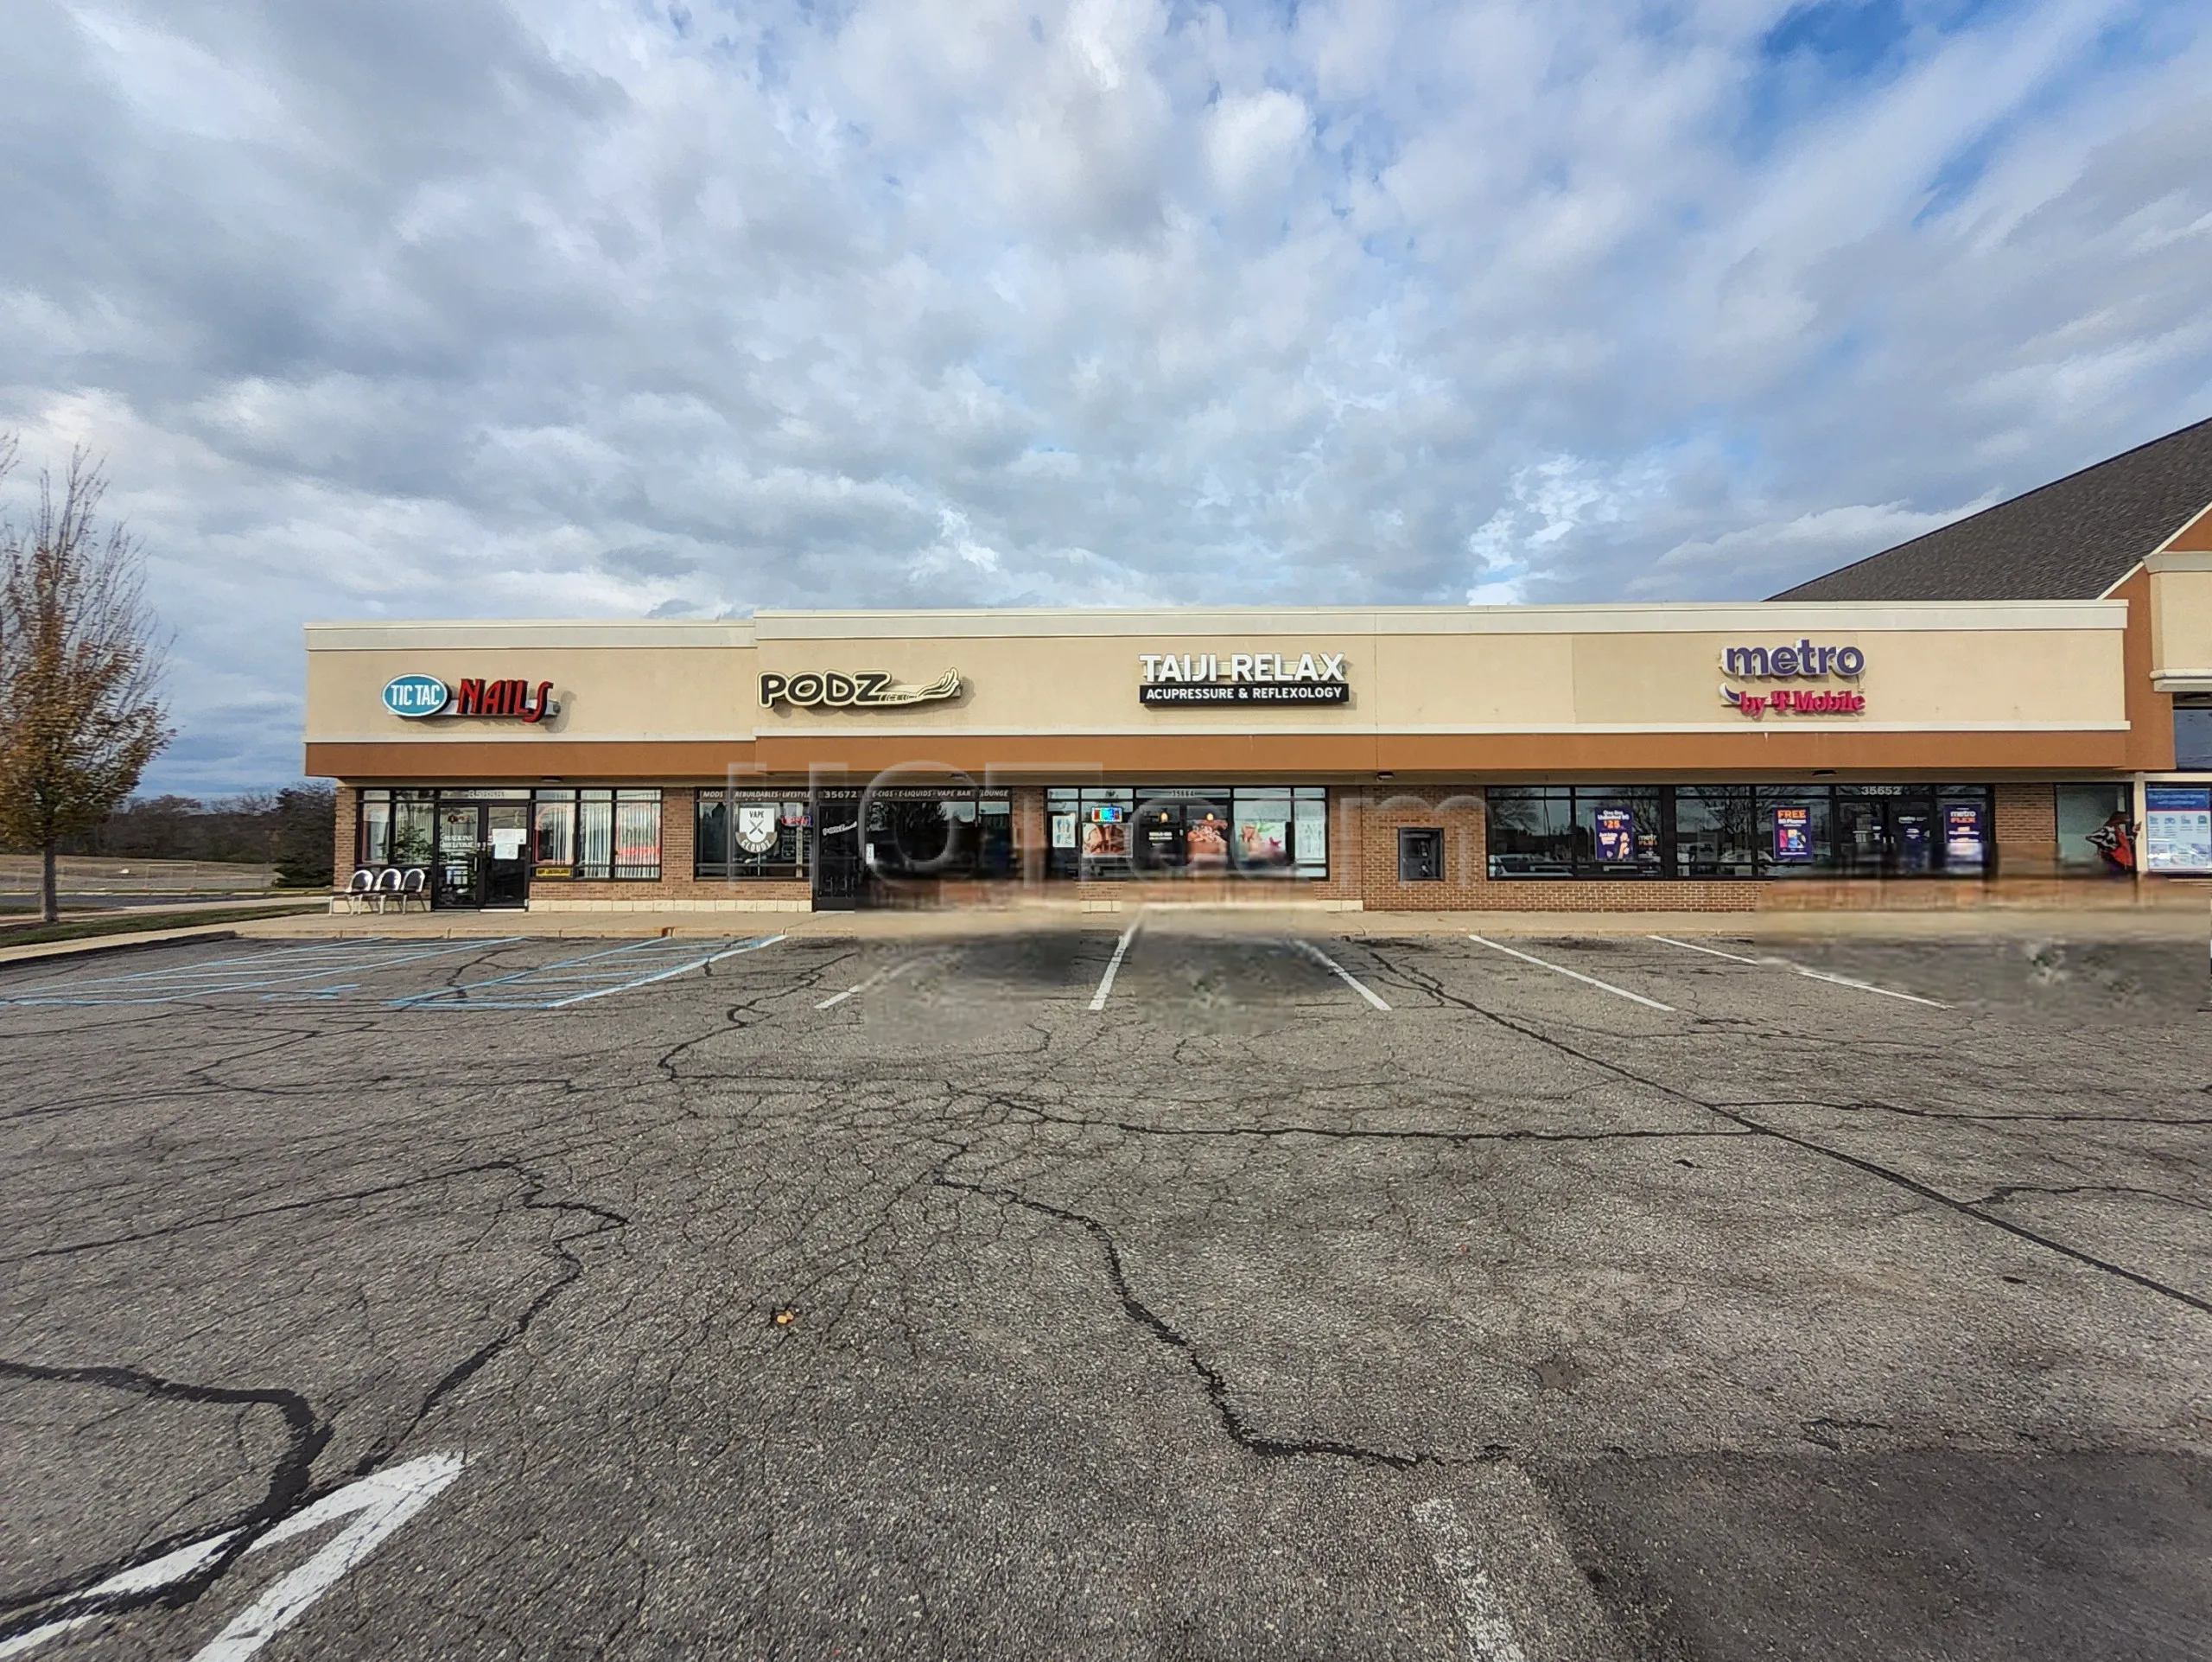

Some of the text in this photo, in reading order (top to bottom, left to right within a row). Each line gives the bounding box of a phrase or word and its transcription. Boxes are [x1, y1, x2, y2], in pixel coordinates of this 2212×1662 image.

[1726, 639, 1865, 676] metro
[1139, 653, 1344, 683] TAIJI RELAX
[391, 685, 441, 706] TIC TAC
[758, 671, 892, 706] PODZ
[1146, 688, 1342, 699] ACUPRESSURE & REFLEXOLOGY
[456, 678, 554, 723] NAILS
[1739, 691, 1767, 719] by
[702, 789, 724, 799] MODS
[824, 790, 857, 799] 35672
[1861, 786, 1901, 795] 35652
[1777, 809, 1806, 818] FREE
[741, 838, 772, 851] CLOUDZ
